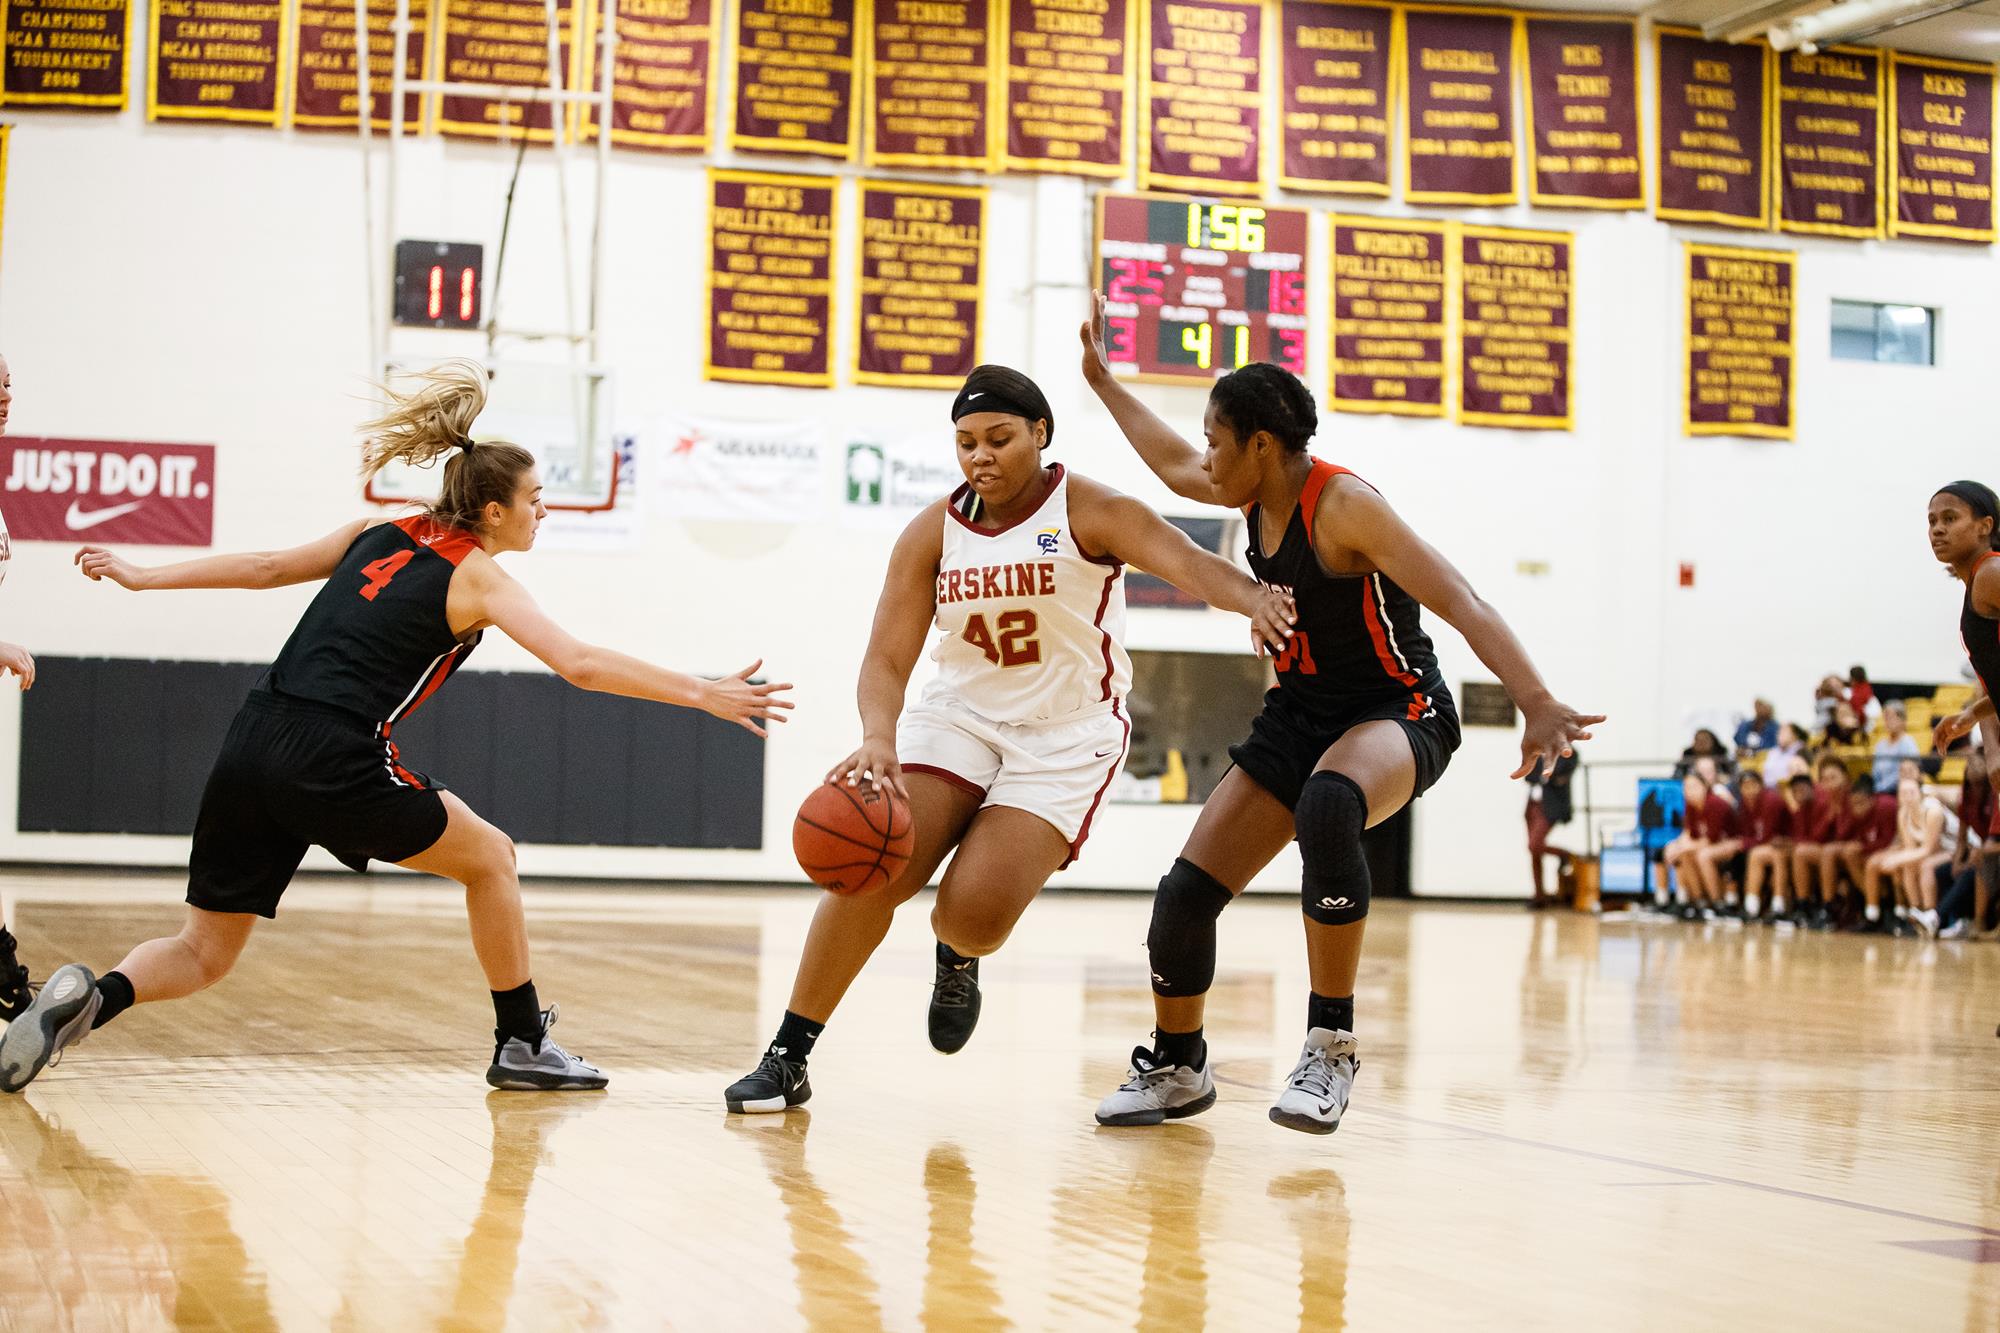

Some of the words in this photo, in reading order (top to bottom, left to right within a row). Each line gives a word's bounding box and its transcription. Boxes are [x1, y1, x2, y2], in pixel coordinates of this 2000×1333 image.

[20, 11, 107, 30] CHAMPIONS
[176, 20, 262, 41] CHAMPIONS
[49, 32, 121, 51] REGIONAL
[1296, 24, 1377, 53] BASEBALL
[12, 50, 112, 70] TOURNAMENT
[1421, 47, 1500, 75] BASEBALL
[1923, 101, 1966, 127] GOLF
[744, 185, 804, 211] MEN'S
[894, 196, 953, 223] MEN'S
[714, 206, 830, 239] VOLLEYBALL
[864, 217, 980, 247] VOLLEYBALL
[1187, 203, 1266, 252] 1:56
[1352, 230, 1430, 258] WOMEN'S
[1477, 239, 1556, 268] WOMEN'S
[1109, 258, 1165, 306] 25
[1336, 254, 1442, 283] VOLLEYBALL
[1464, 263, 1568, 292] VOLLEYBALL
[1704, 257, 1779, 286] WOMEN'S
[428, 265, 475, 321] 11
[1691, 279, 1790, 308] VOLLEYBALL
[1108, 317, 1137, 363] 3
[5, 448, 97, 494] JUST
[99, 452, 157, 497] DO
[159, 454, 210, 500] IT.
[359, 549, 416, 602] 4
[938, 562, 1056, 604] ERSKINE
[961, 607, 1042, 669] 42
